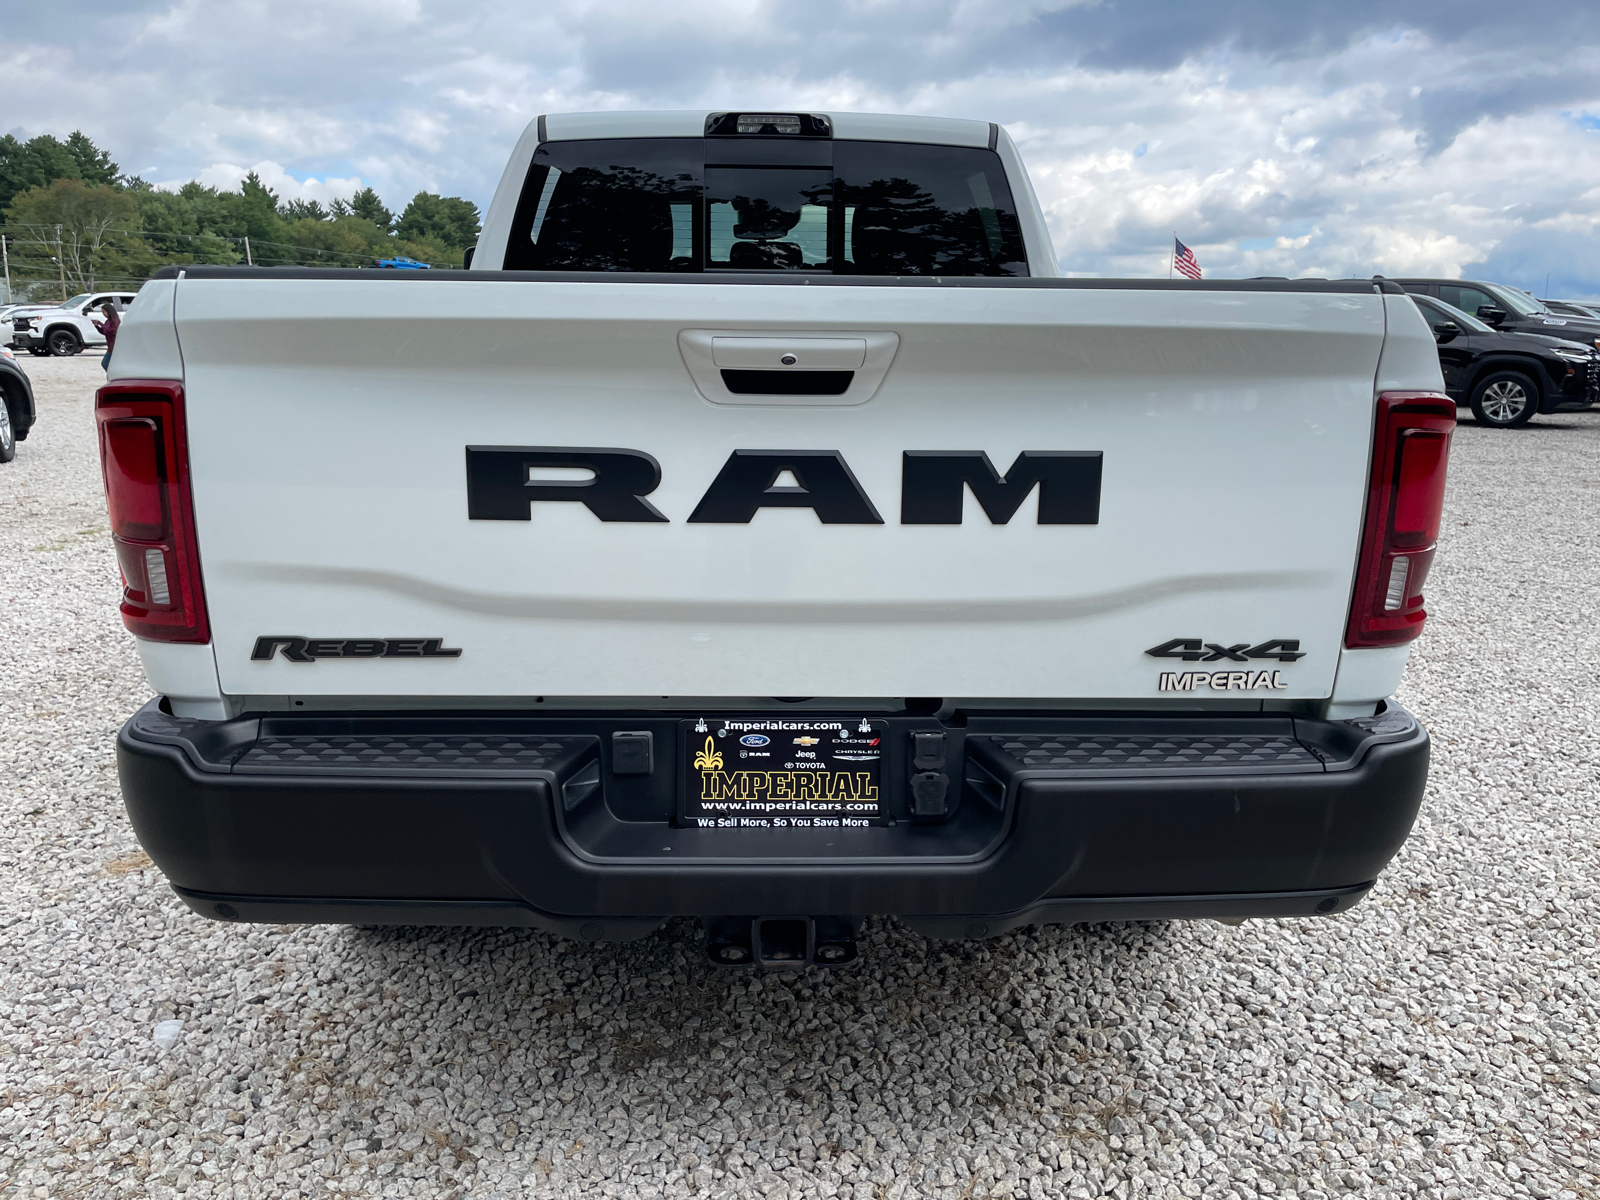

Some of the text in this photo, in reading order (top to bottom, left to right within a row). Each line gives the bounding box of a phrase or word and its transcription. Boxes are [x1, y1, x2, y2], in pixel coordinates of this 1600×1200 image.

[465, 444, 1104, 526] RAM
[250, 635, 463, 663] REBEL
[1144, 637, 1307, 662] 4x4
[1158, 670, 1289, 692] IMPERIAL
[724, 720, 842, 733] Imperialcars.com
[746, 736, 764, 745] Ford
[795, 750, 816, 759] Jeep
[701, 771, 879, 800] IMPERIAL
[698, 818, 869, 828] We Sell More, So You Save More
